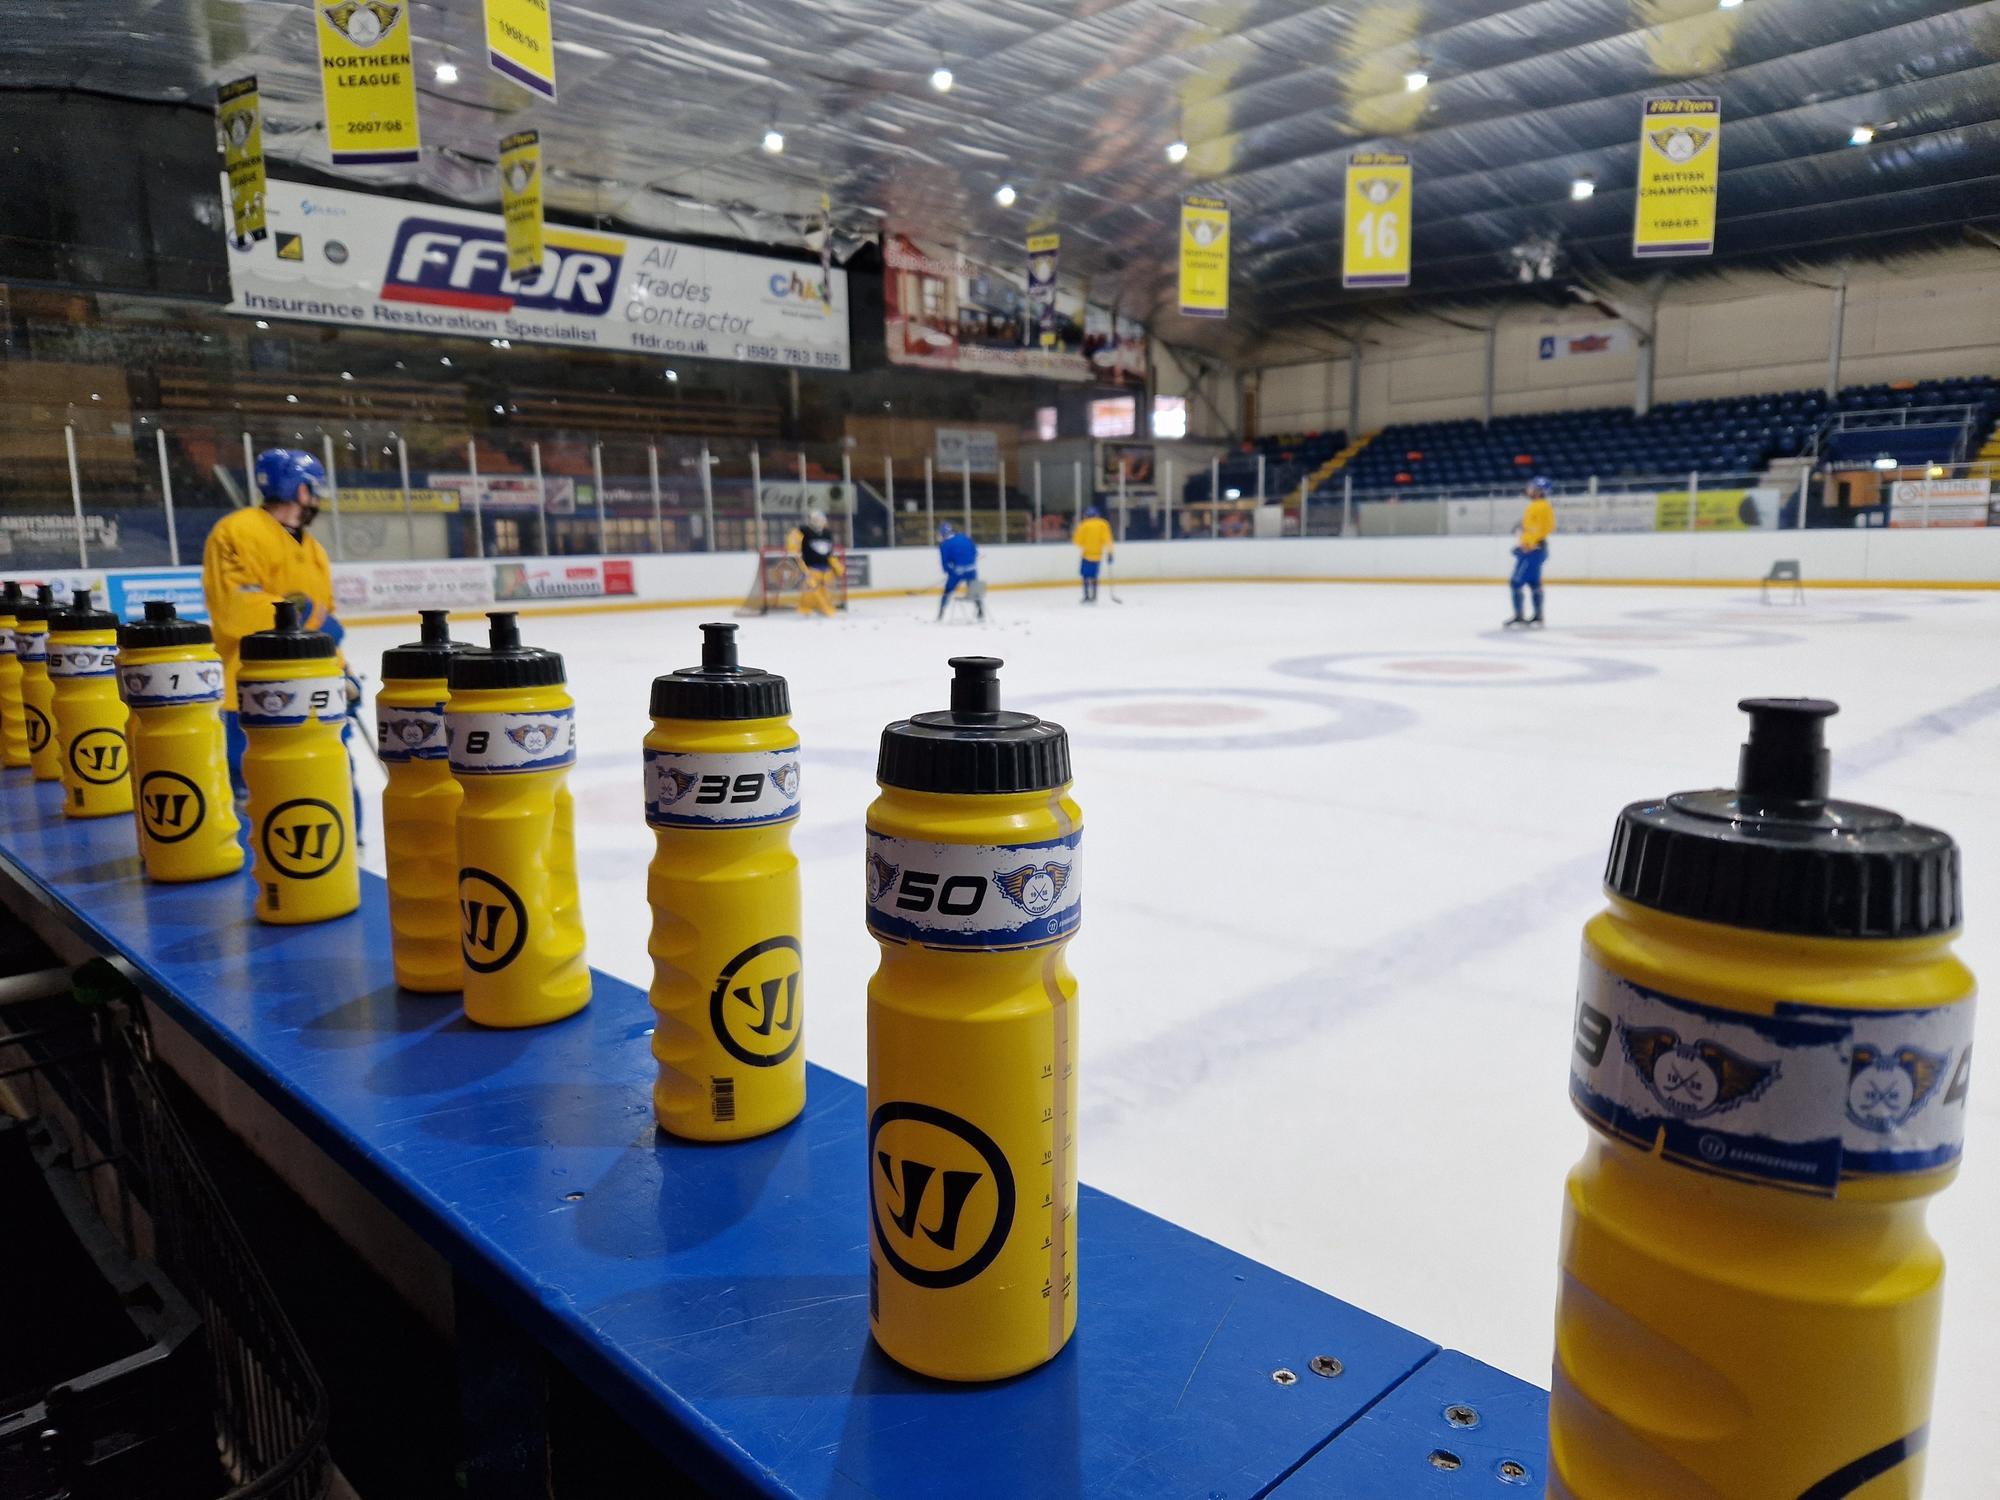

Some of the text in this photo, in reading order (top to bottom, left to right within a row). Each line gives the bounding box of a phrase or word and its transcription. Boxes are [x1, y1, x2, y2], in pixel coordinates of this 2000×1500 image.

[324, 54, 411, 70] NORTHERN
[338, 73, 401, 87] LEAGUE
[1652, 171, 1706, 184] BRITISH
[1356, 210, 1400, 260] 16
[396, 231, 613, 306] FFDR
[642, 245, 677, 271] All
[635, 272, 712, 303] Trades
[244, 290, 600, 343] Insurance Restoration Specialist
[623, 299, 754, 335] Contractor
[631, 331, 709, 354] ffdr.co.uk
[168, 674, 180, 690] 1
[310, 690, 330, 710] 9
[465, 731, 490, 755] 8
[694, 772, 767, 805] 39
[895, 869, 989, 917] 50
